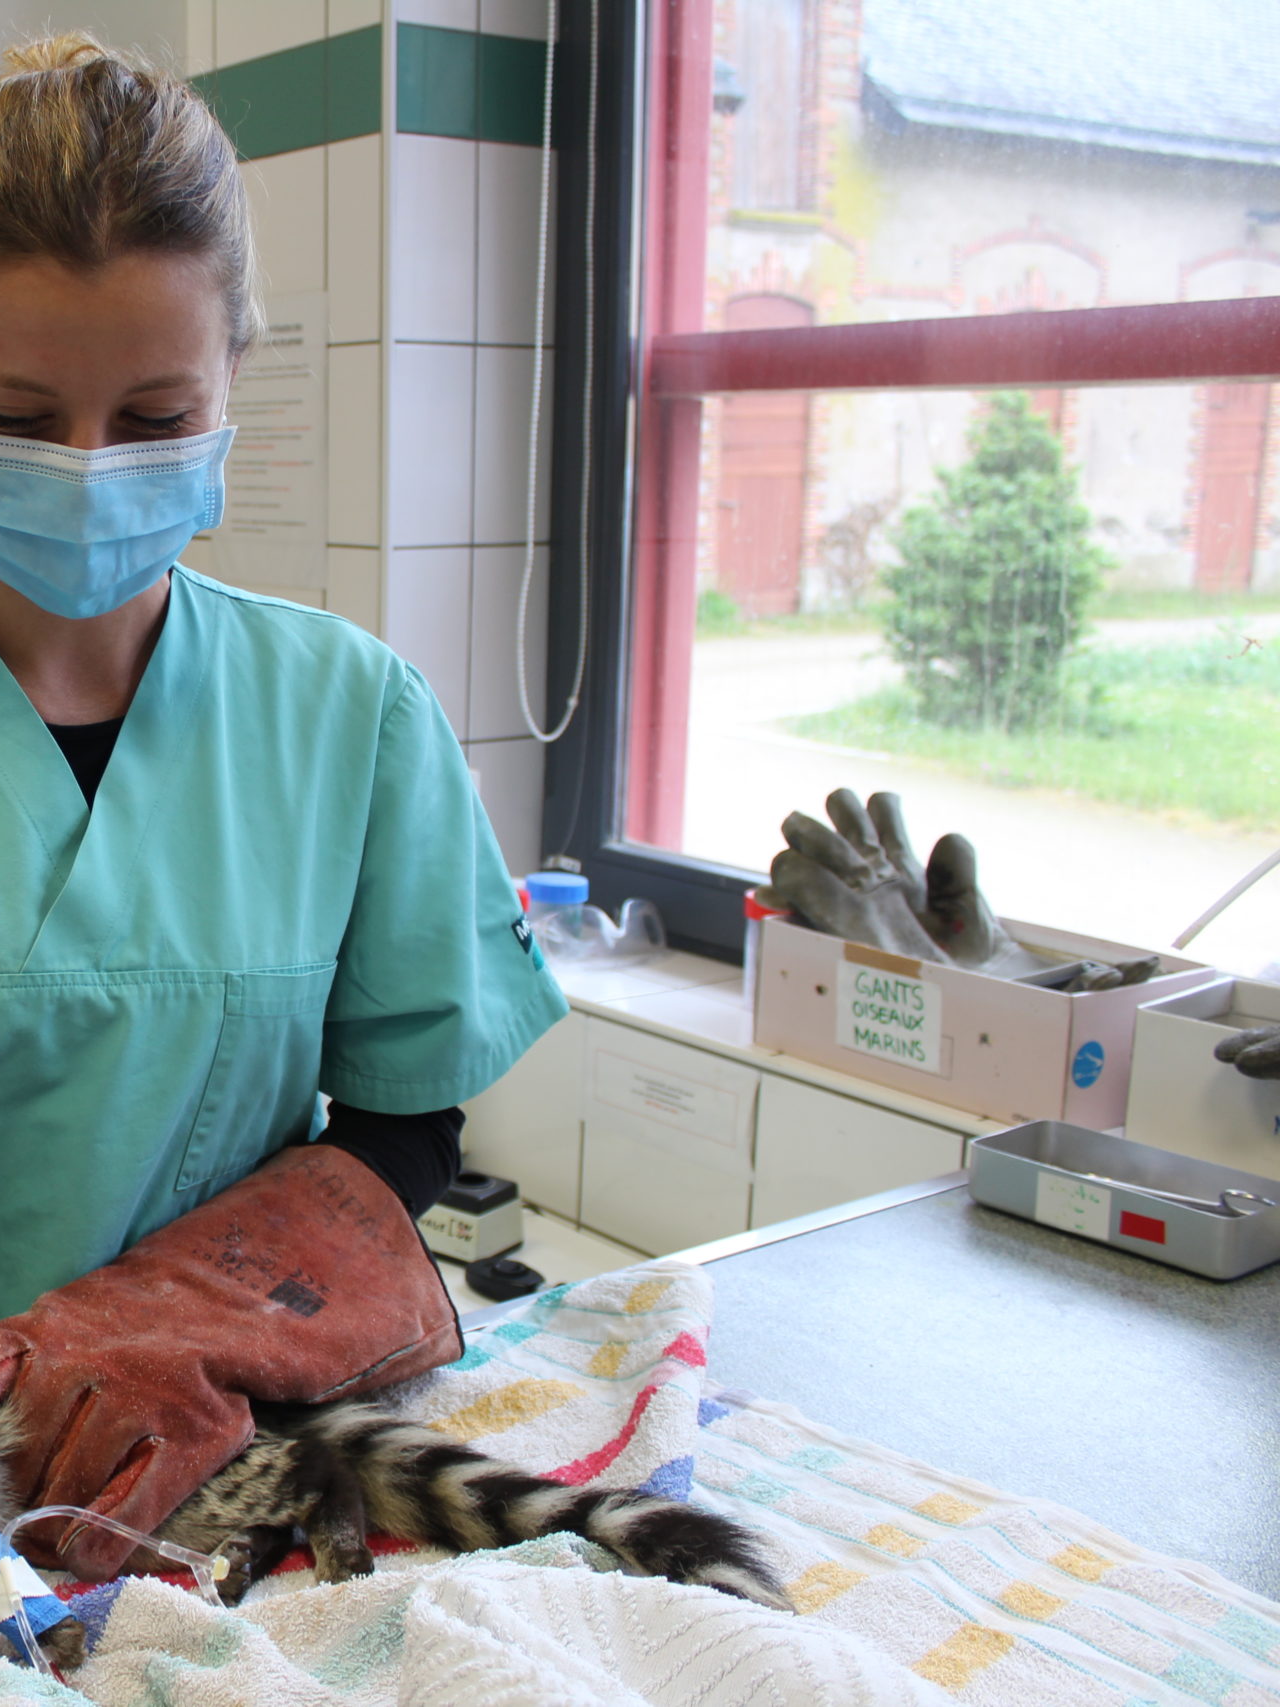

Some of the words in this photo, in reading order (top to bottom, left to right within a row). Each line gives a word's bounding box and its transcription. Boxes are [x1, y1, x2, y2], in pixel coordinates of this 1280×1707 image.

[854, 970, 925, 1011] GANTS
[852, 1000, 926, 1032] OISEAUX
[854, 1024, 926, 1062] MARINS
